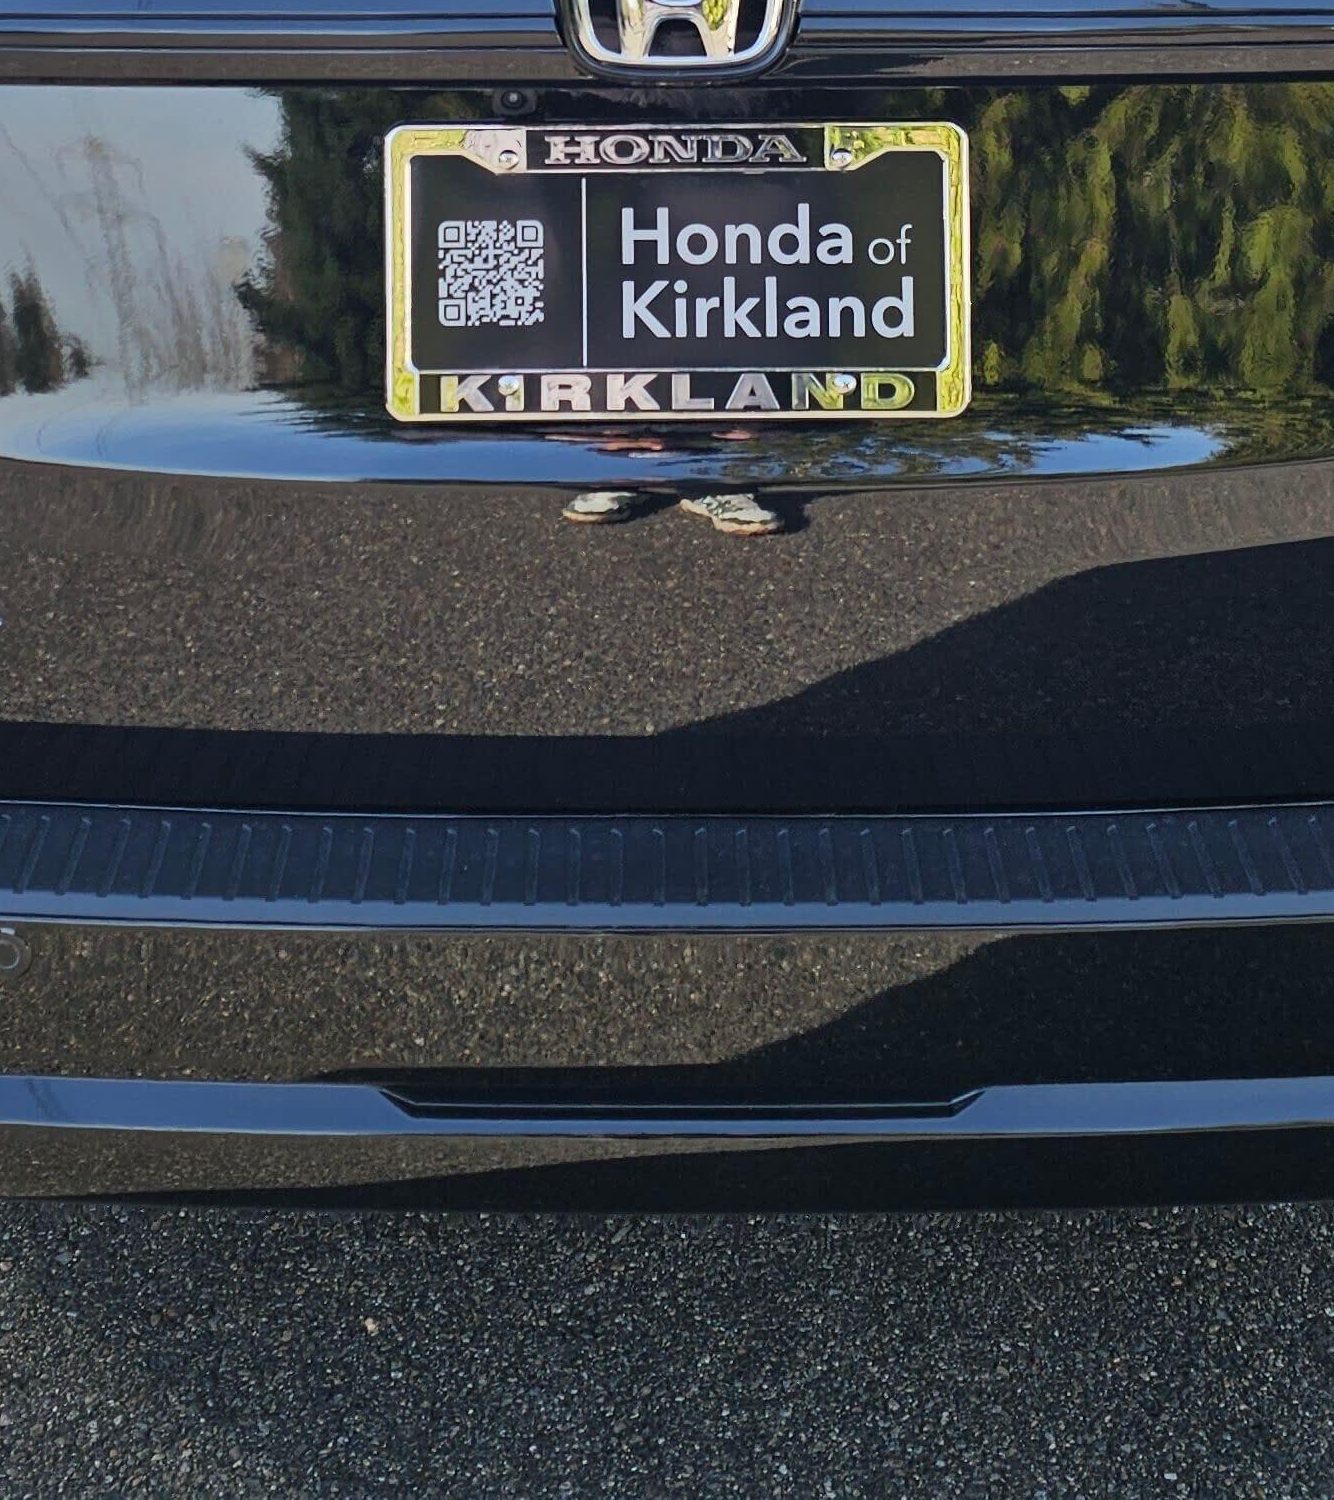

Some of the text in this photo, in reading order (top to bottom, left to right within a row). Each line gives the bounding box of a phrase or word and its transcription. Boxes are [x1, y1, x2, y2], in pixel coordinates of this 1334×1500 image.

[544, 134, 806, 166] HONDA
[621, 203, 913, 266] Honda of
[622, 276, 915, 338] Kirkland
[440, 373, 915, 412] KIRKLAND
